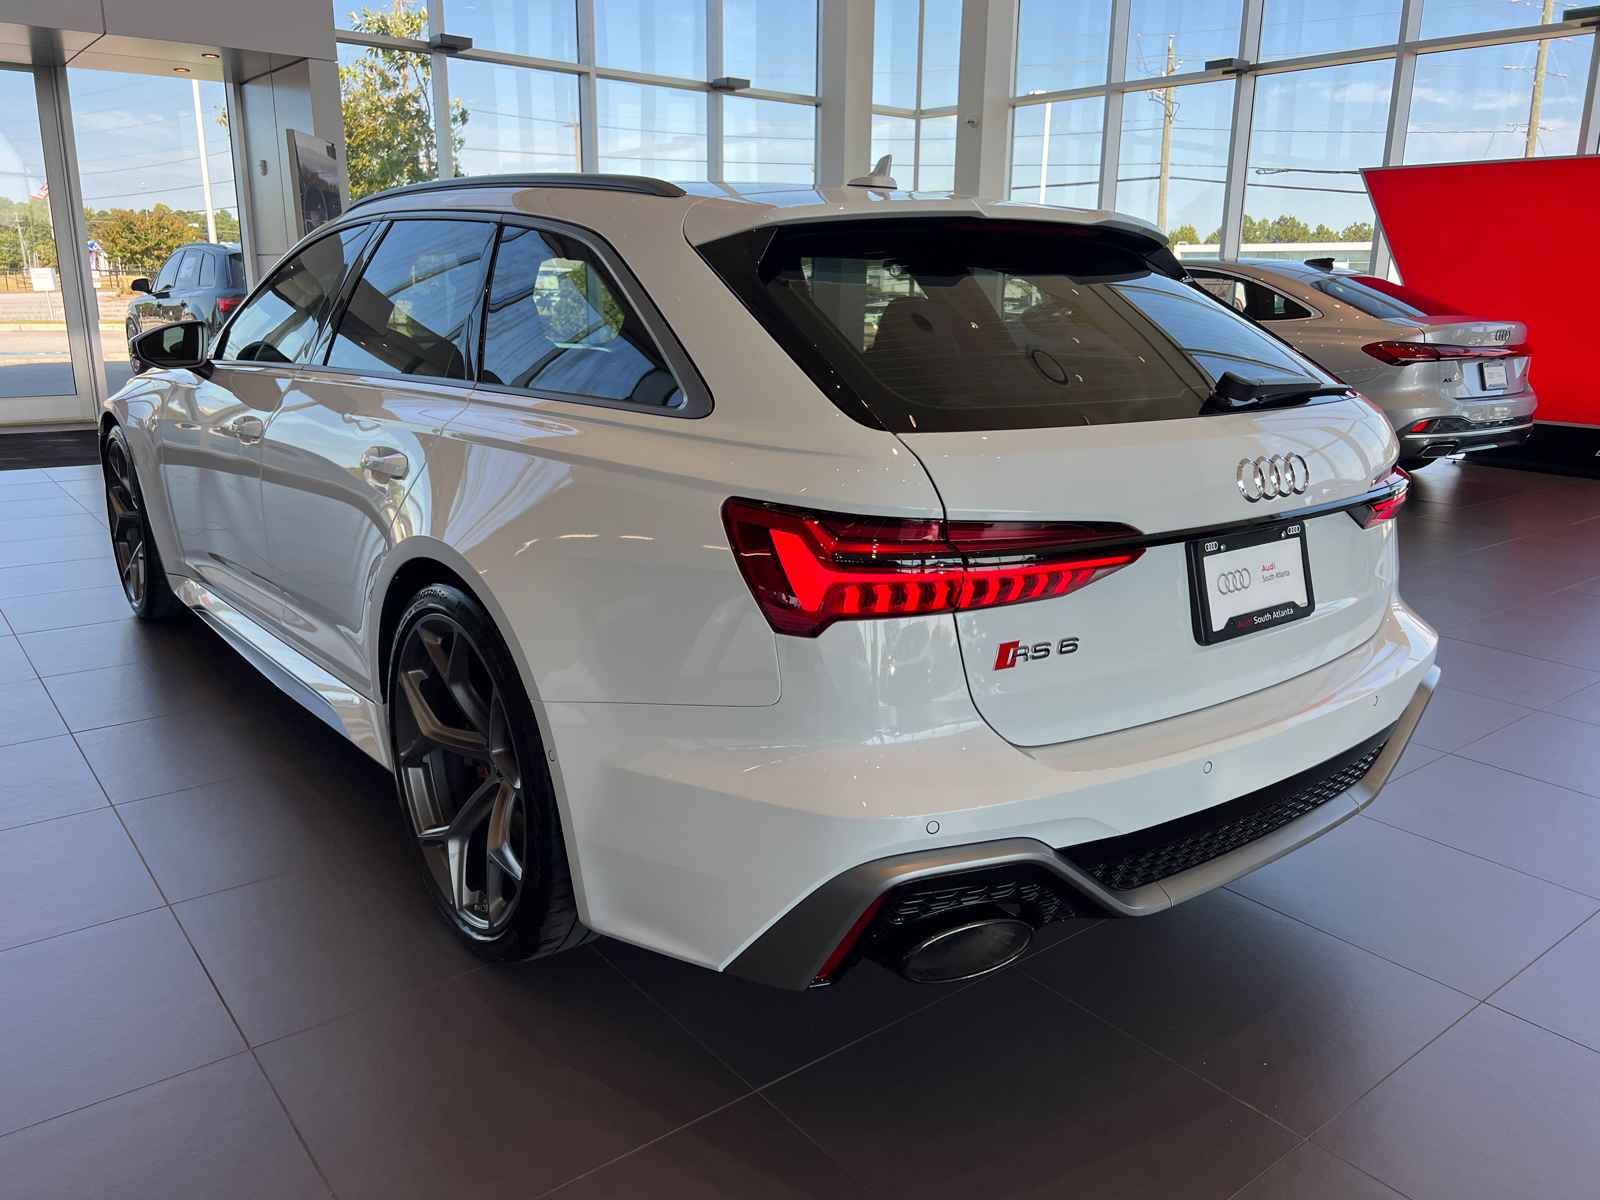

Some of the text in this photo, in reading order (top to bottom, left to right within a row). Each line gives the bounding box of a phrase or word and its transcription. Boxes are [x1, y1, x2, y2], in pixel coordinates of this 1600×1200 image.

[1262, 562, 1275, 572] Audi
[1262, 570, 1290, 582] South Atlanta
[1237, 608, 1293, 628] Audi South Atlanta
[1006, 636, 1080, 665] RS 6
